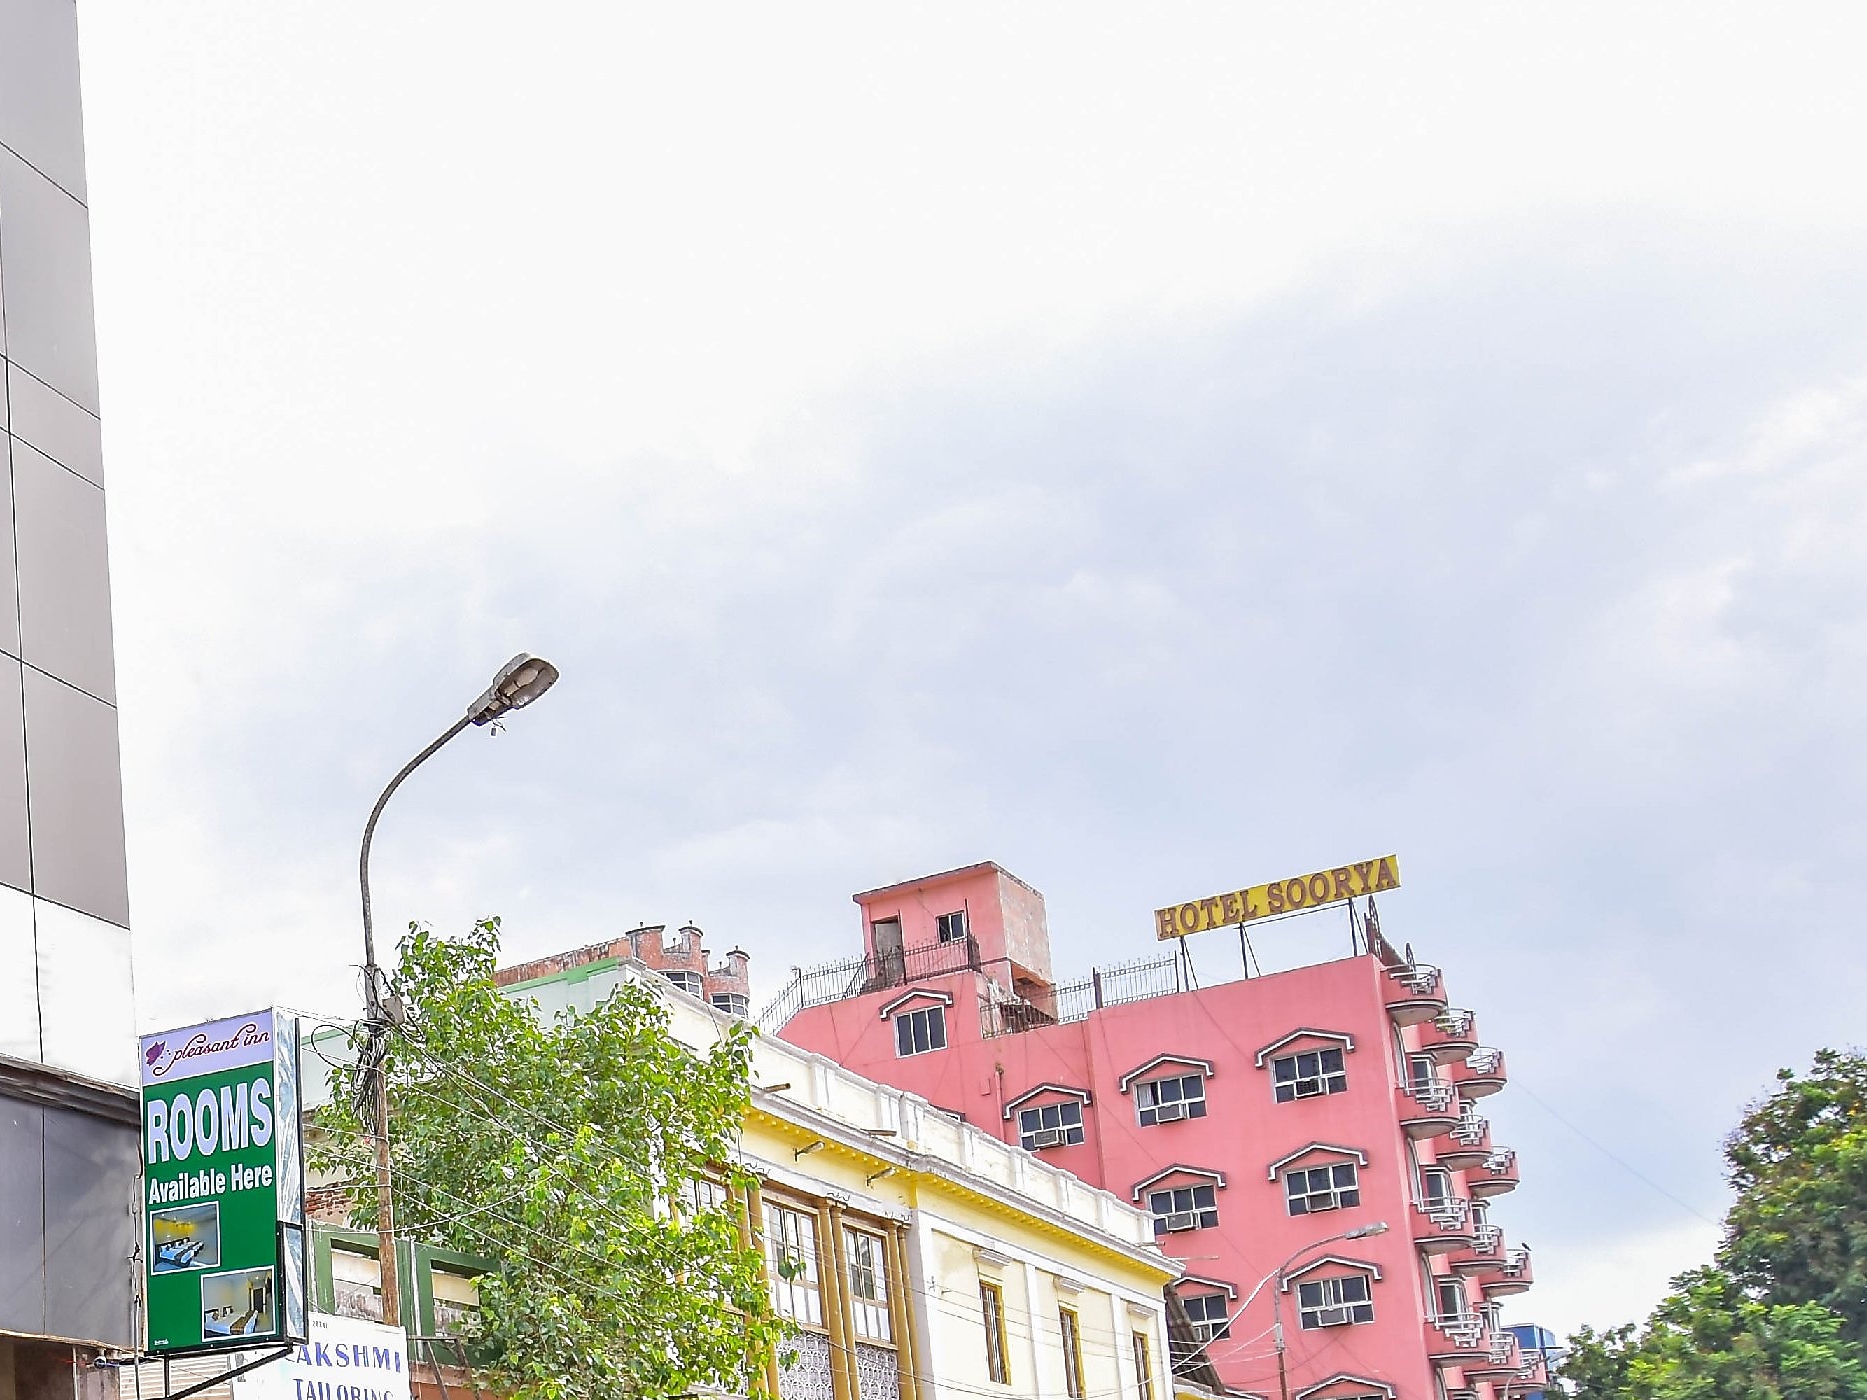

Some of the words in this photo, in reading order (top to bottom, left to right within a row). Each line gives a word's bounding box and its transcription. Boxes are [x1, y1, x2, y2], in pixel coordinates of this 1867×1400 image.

[1157, 889, 1258, 939] HOTEL
[1266, 857, 1397, 914] SOORYA
[153, 1026, 252, 1076] pleasant
[243, 1031, 270, 1048] inn
[147, 1077, 273, 1164] ROOMS
[148, 1168, 226, 1205] Available
[230, 1163, 273, 1193] Here
[285, 1341, 402, 1373] AKSHMI
